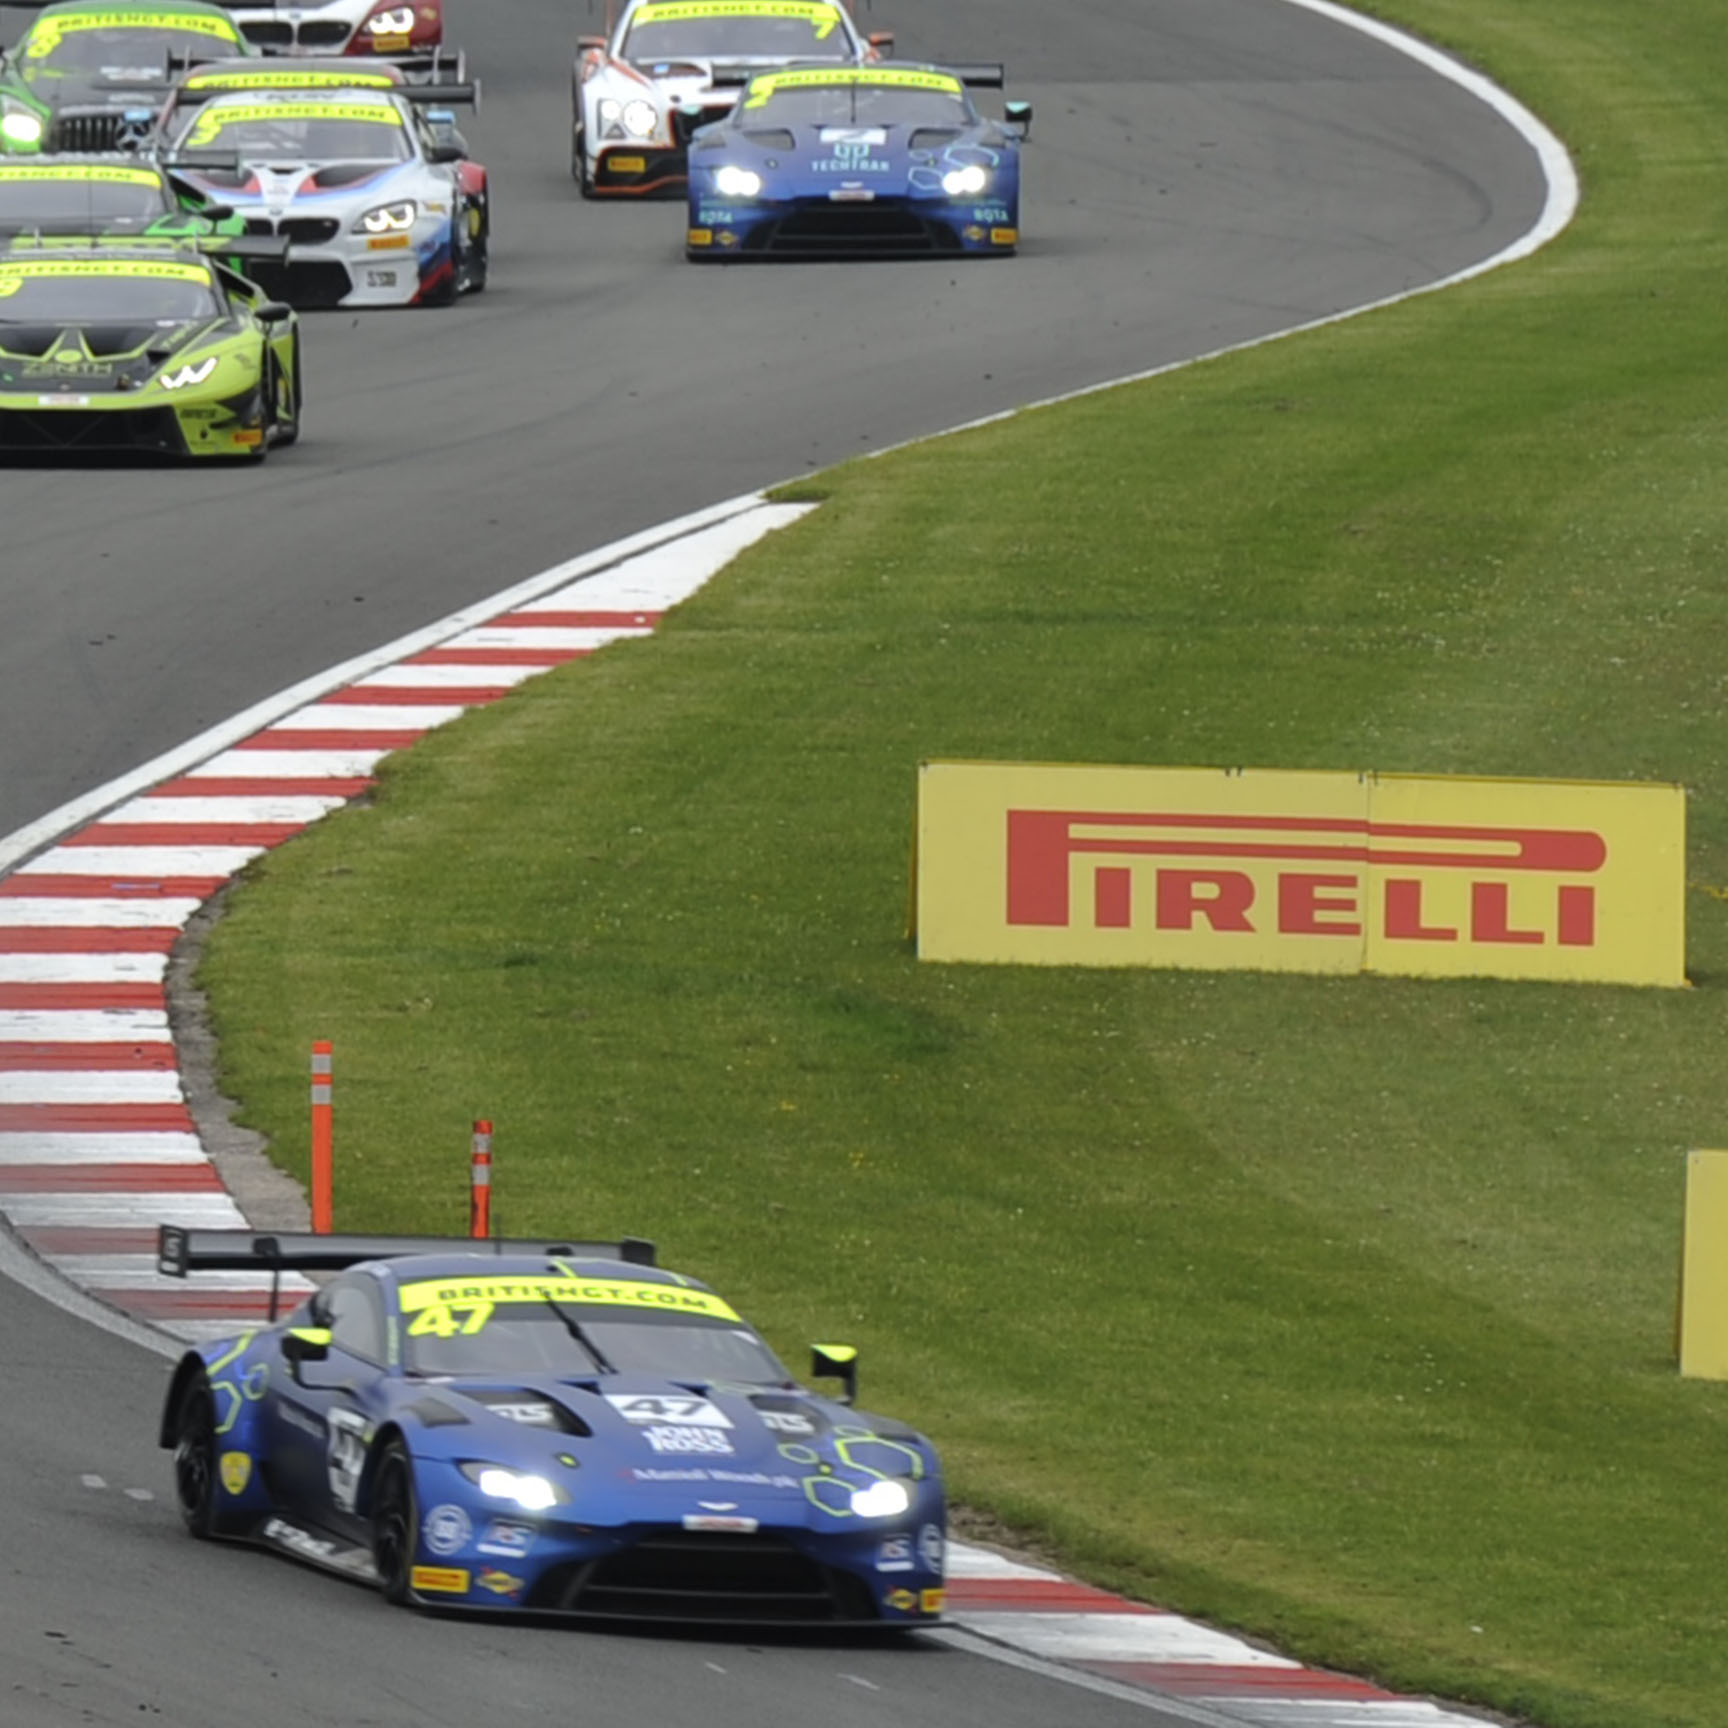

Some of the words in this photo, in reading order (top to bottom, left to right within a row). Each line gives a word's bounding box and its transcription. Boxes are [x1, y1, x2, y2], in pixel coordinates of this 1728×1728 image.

[1006, 809, 1607, 946] PIRELLI
[437, 1284, 708, 1310] BRITISHGT.COM
[407, 1302, 496, 1338] 47
[622, 1396, 707, 1417] 47
